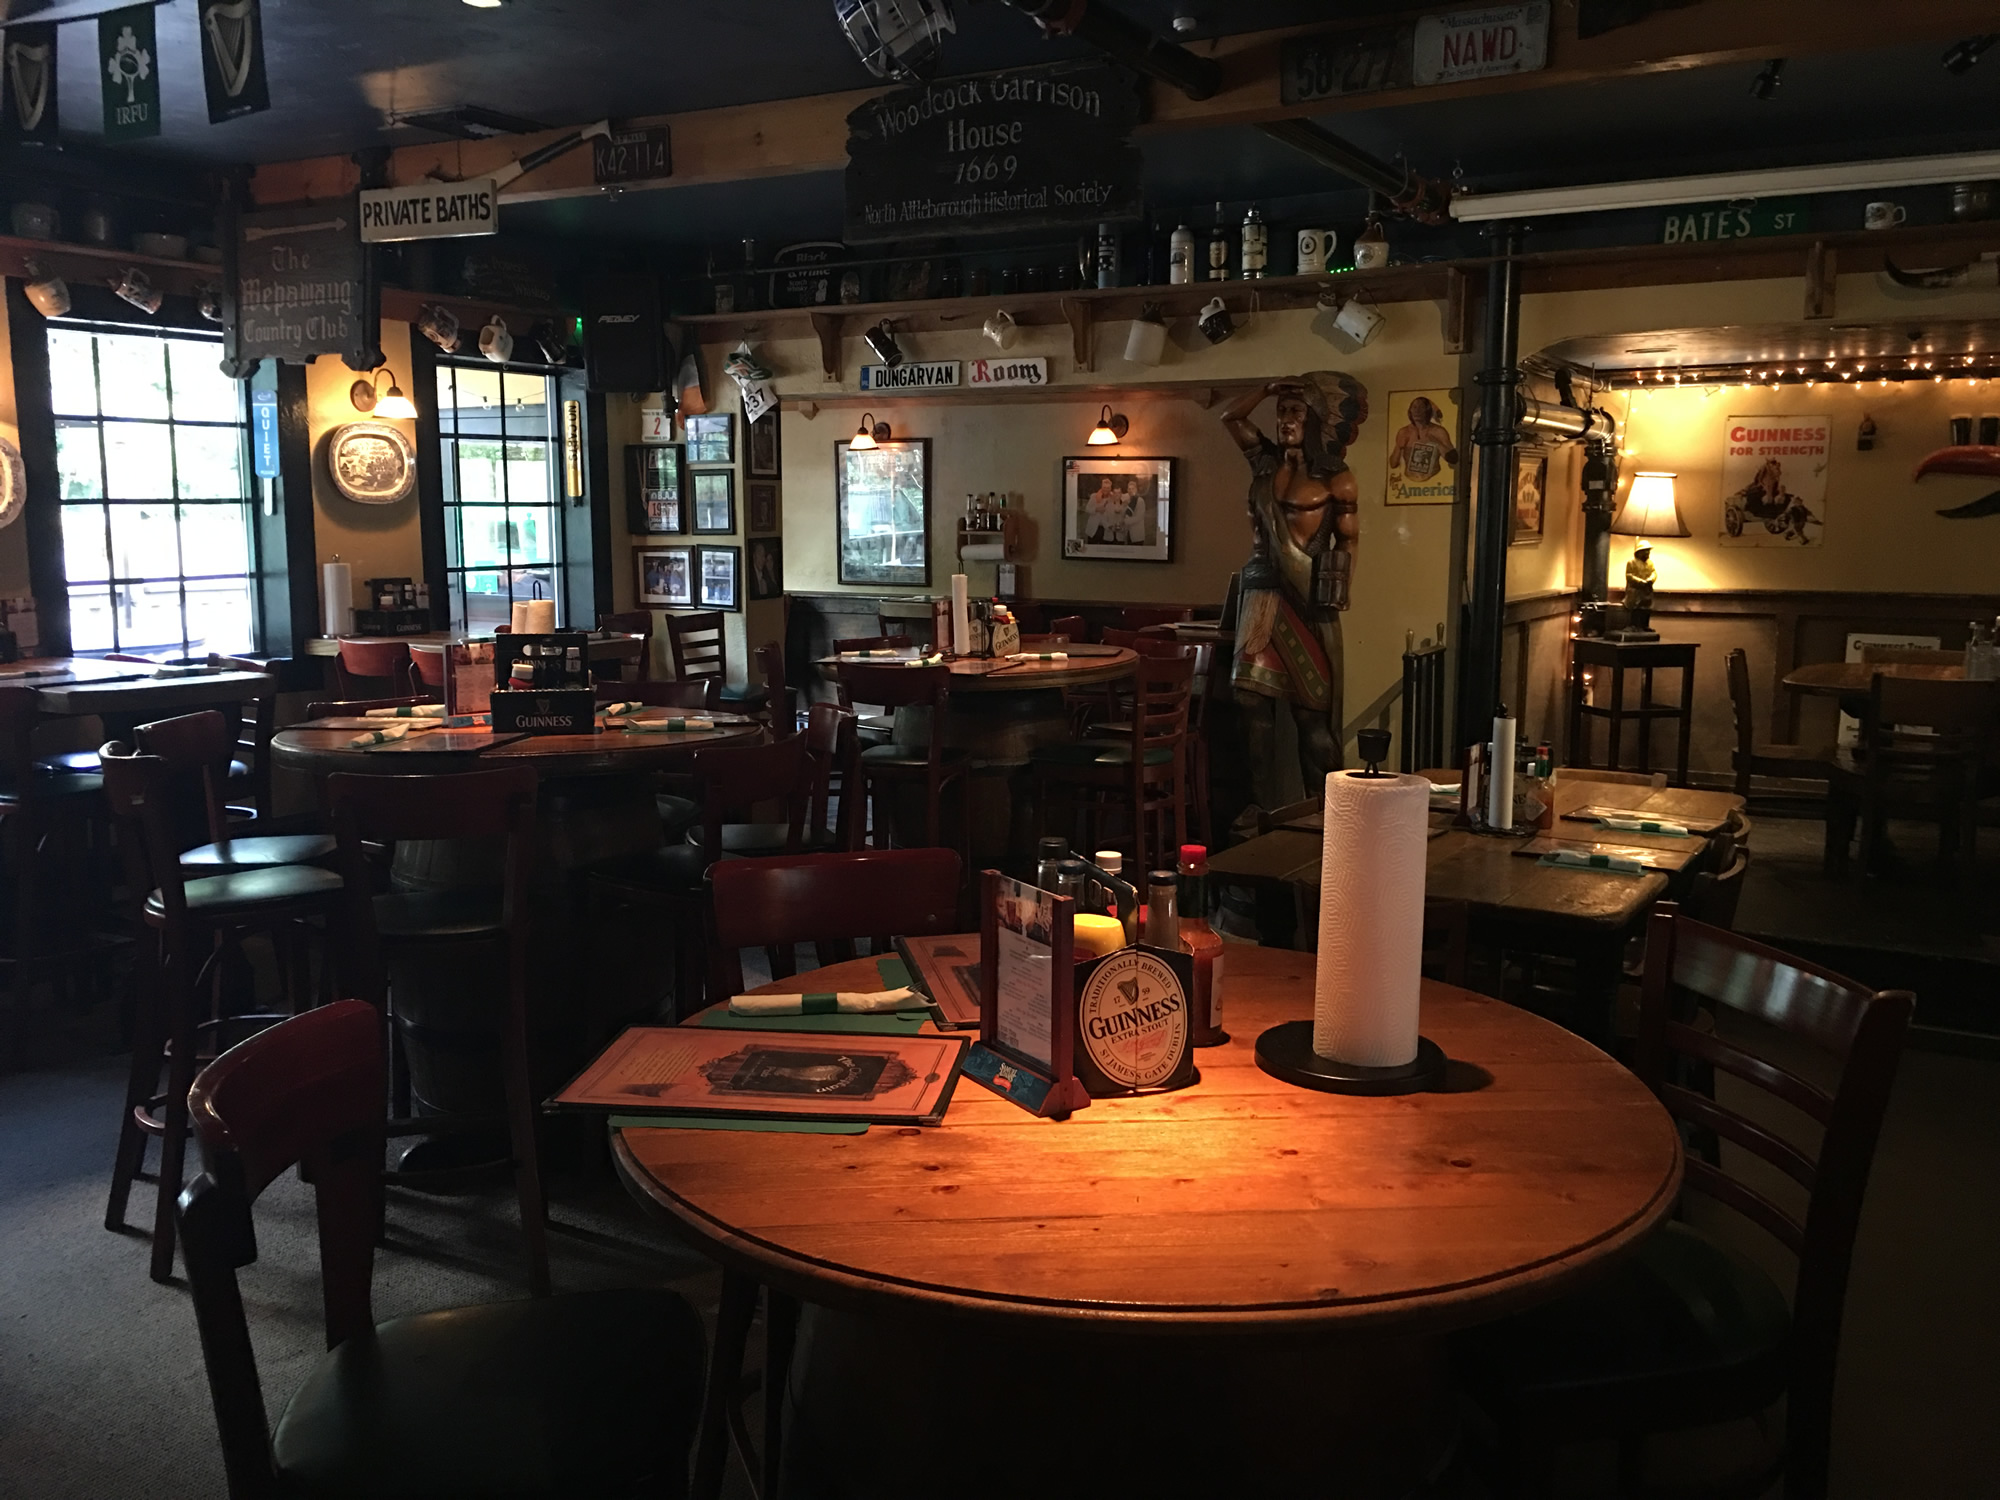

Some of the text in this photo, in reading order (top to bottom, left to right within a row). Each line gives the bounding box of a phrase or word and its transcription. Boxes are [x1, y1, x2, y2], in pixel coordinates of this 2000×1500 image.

[1442, 26, 1517, 68] NAWD
[116, 103, 148, 125] IRFU
[876, 75, 1100, 142] Woodcock Garrison
[948, 118, 1023, 152] House
[953, 154, 1018, 184] 1669
[363, 192, 490, 227] PRIVATE BATHS
[865, 204, 896, 225] North
[984, 186, 1048, 213] Historical
[1054, 181, 1113, 206] Society
[1663, 208, 1796, 244] BATES ST
[272, 246, 311, 272] The
[243, 315, 348, 349] Country Club
[876, 366, 953, 388] DUNGARVAN
[971, 359, 1042, 384] Room
[568, 405, 577, 421] NO
[653, 417, 661, 435] 2
[261, 406, 271, 466] QUIET
[1730, 426, 1825, 443] GUINNESS
[1730, 445, 1825, 456] FOR STRENGTH
[1395, 482, 1456, 499] America
[515, 714, 573, 728] GUINNESS
[1141, 962, 1172, 989] BREWED
[1088, 993, 1180, 1040] GUINNESS
[1111, 1028, 1139, 1044] EXTRA
[1141, 1018, 1170, 1035] STOUT
[1144, 1061, 1169, 1079] GATE
[1166, 1022, 1182, 1061] DUBLIN
